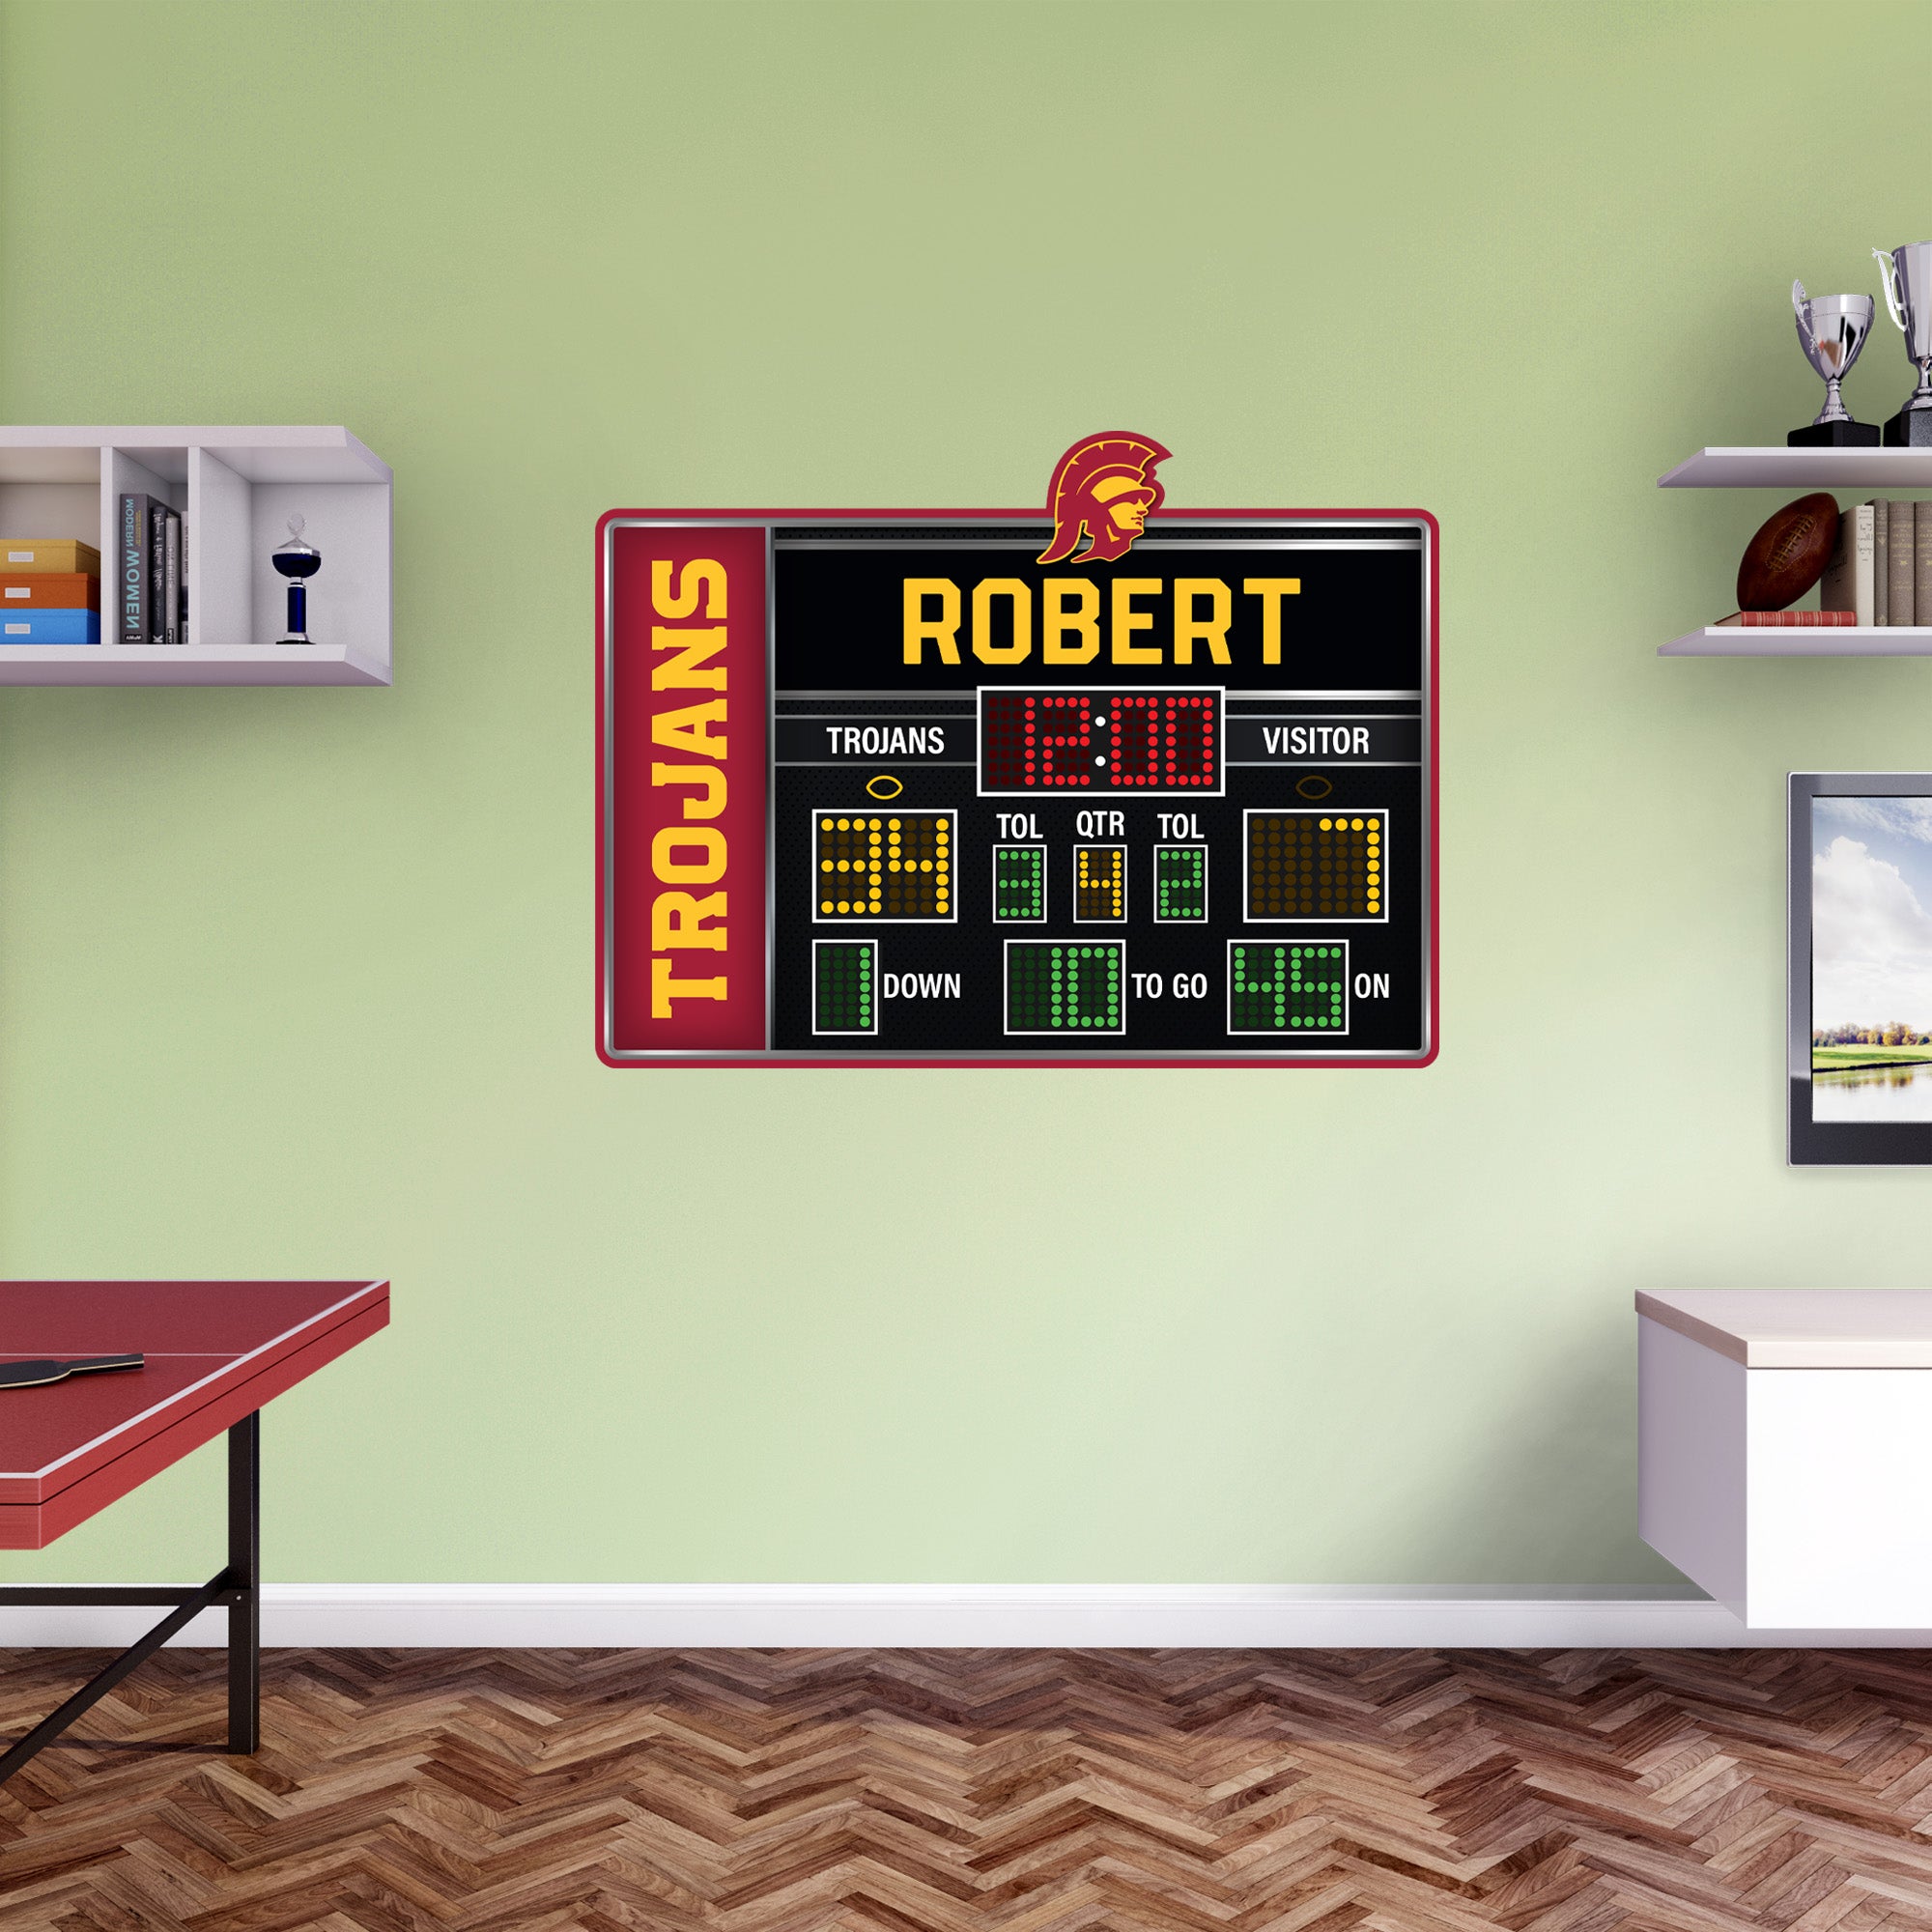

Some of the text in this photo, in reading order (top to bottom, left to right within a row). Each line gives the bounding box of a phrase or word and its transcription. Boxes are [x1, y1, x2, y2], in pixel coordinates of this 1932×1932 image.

[903, 578, 1301, 665] ROBERT
[826, 726, 945, 754] TROJANS
[1025, 696, 1213, 785] 12:00
[1262, 726, 1370, 754] VISITOR
[651, 558, 727, 1019] TROJANS
[996, 812, 1044, 839] TOL
[1076, 810, 1125, 839] QTR
[1156, 812, 1205, 839] TOL
[820, 818, 950, 914] 34
[999, 850, 1041, 917] 3
[1079, 850, 1122, 917] 4
[1159, 851, 1202, 917] 2
[1319, 818, 1380, 914] 7
[859, 947, 961, 1028] 1 DOWN
[1051, 947, 1208, 1028] 10 TO GO
[1234, 947, 1390, 1028] 45 ON
